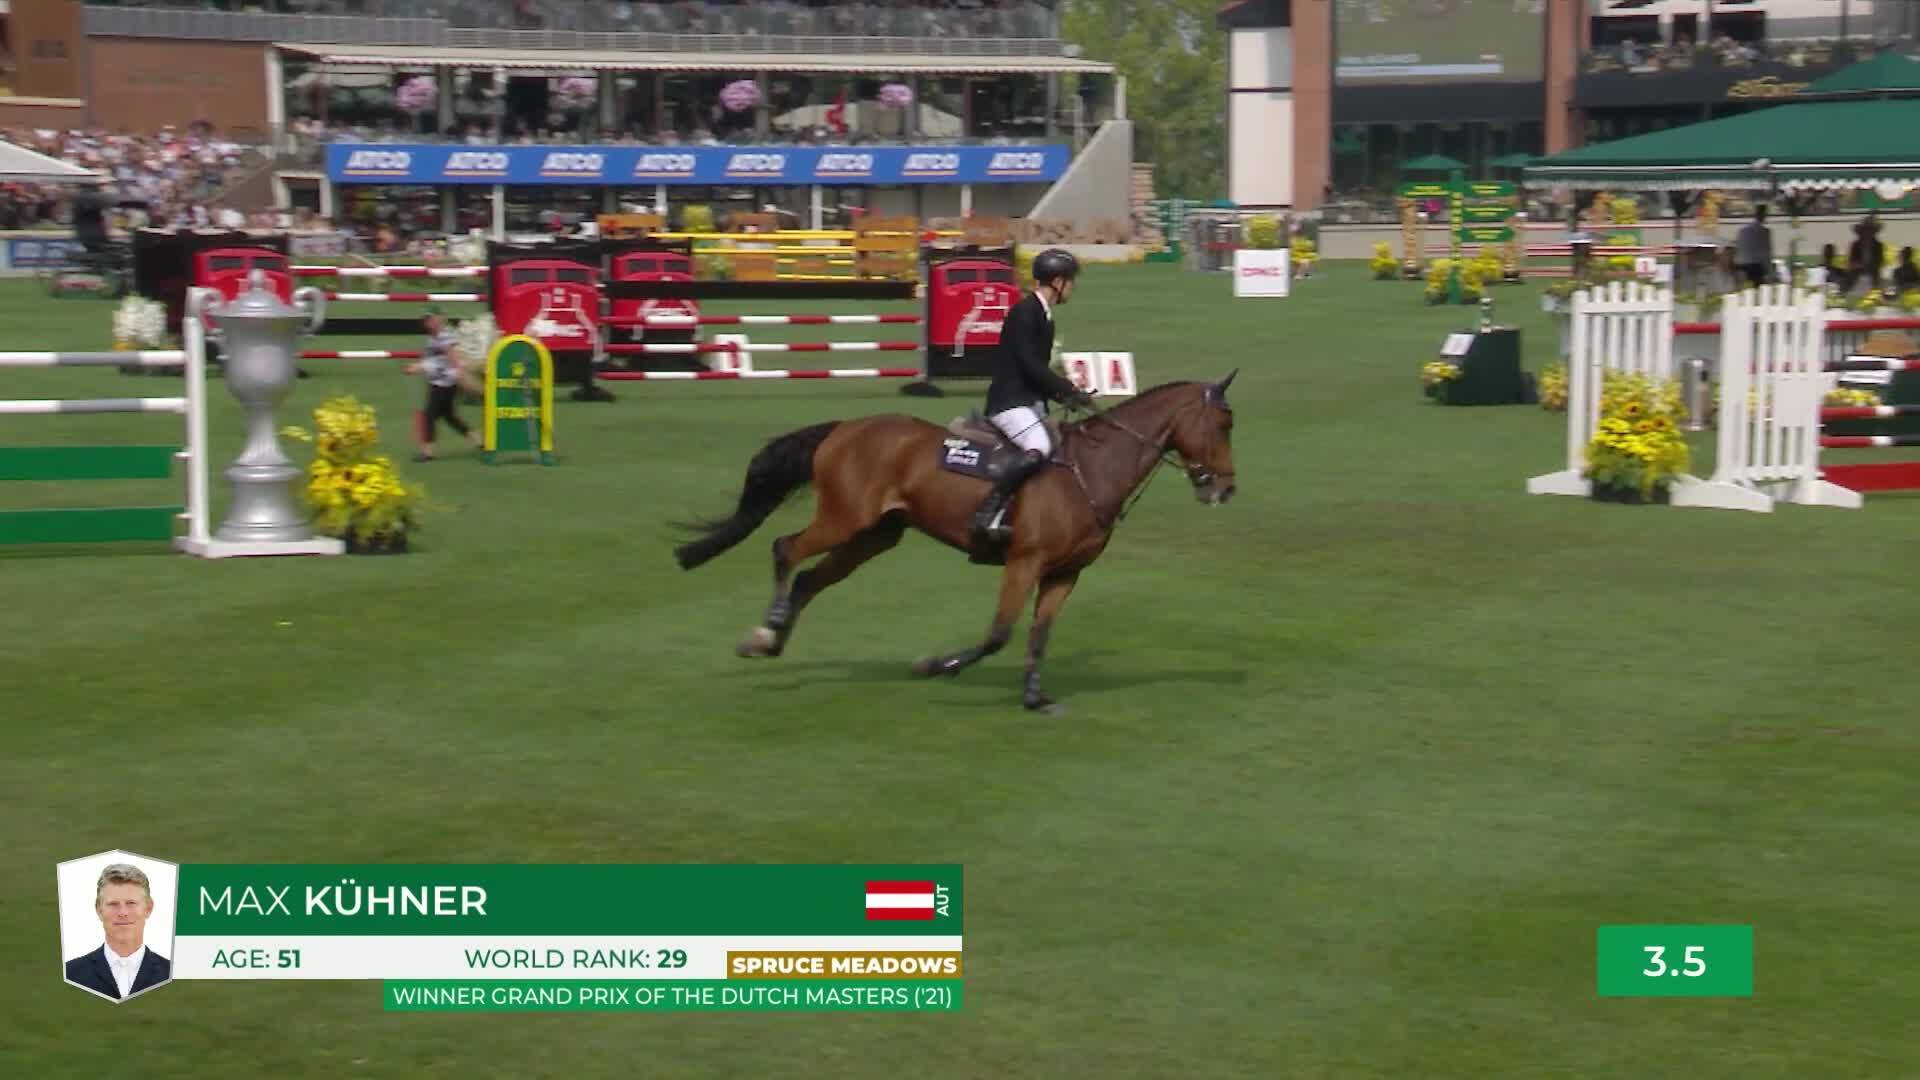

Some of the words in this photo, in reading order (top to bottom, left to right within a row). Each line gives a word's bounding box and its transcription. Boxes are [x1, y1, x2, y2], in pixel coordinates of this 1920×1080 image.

[346, 151, 411, 169] ATCO
[445, 152, 509, 169] ATCO
[541, 152, 604, 170] ATCO
[635, 153, 696, 170] ATCO
[727, 153, 785, 170] ATCO
[815, 153, 873, 170] ATCO
[903, 153, 960, 170] ATCO
[986, 152, 1044, 169] ATCO
[1110, 360, 1128, 389] A
